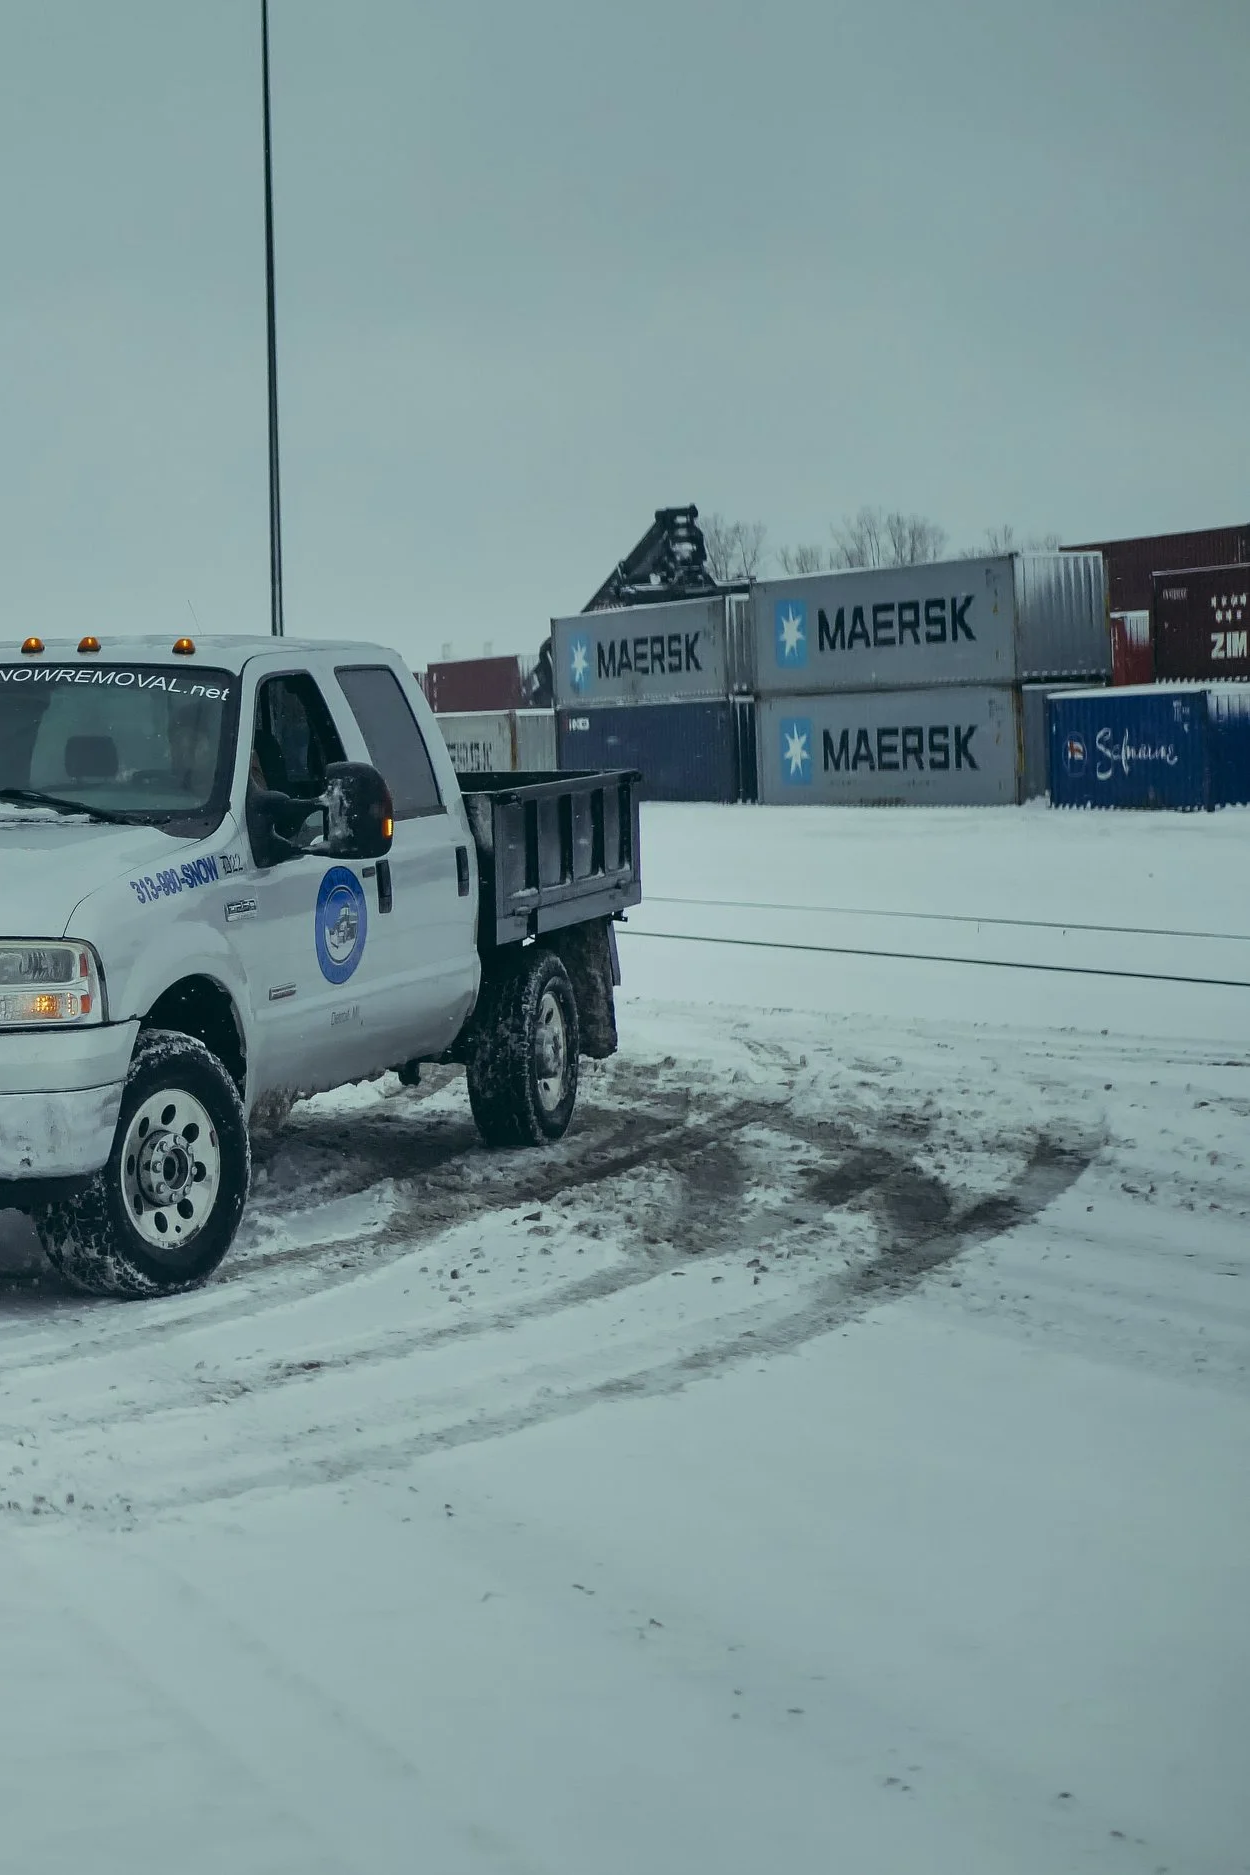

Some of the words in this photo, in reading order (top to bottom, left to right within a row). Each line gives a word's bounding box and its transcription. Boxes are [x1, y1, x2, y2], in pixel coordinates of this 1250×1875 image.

[817, 595, 977, 652] MAERSK
[1211, 631, 1247, 659] ZIM
[597, 631, 702, 679] MAERSK
[822, 725, 981, 772] MAERSK
[129, 855, 220, 904] 313-980-SNOW
